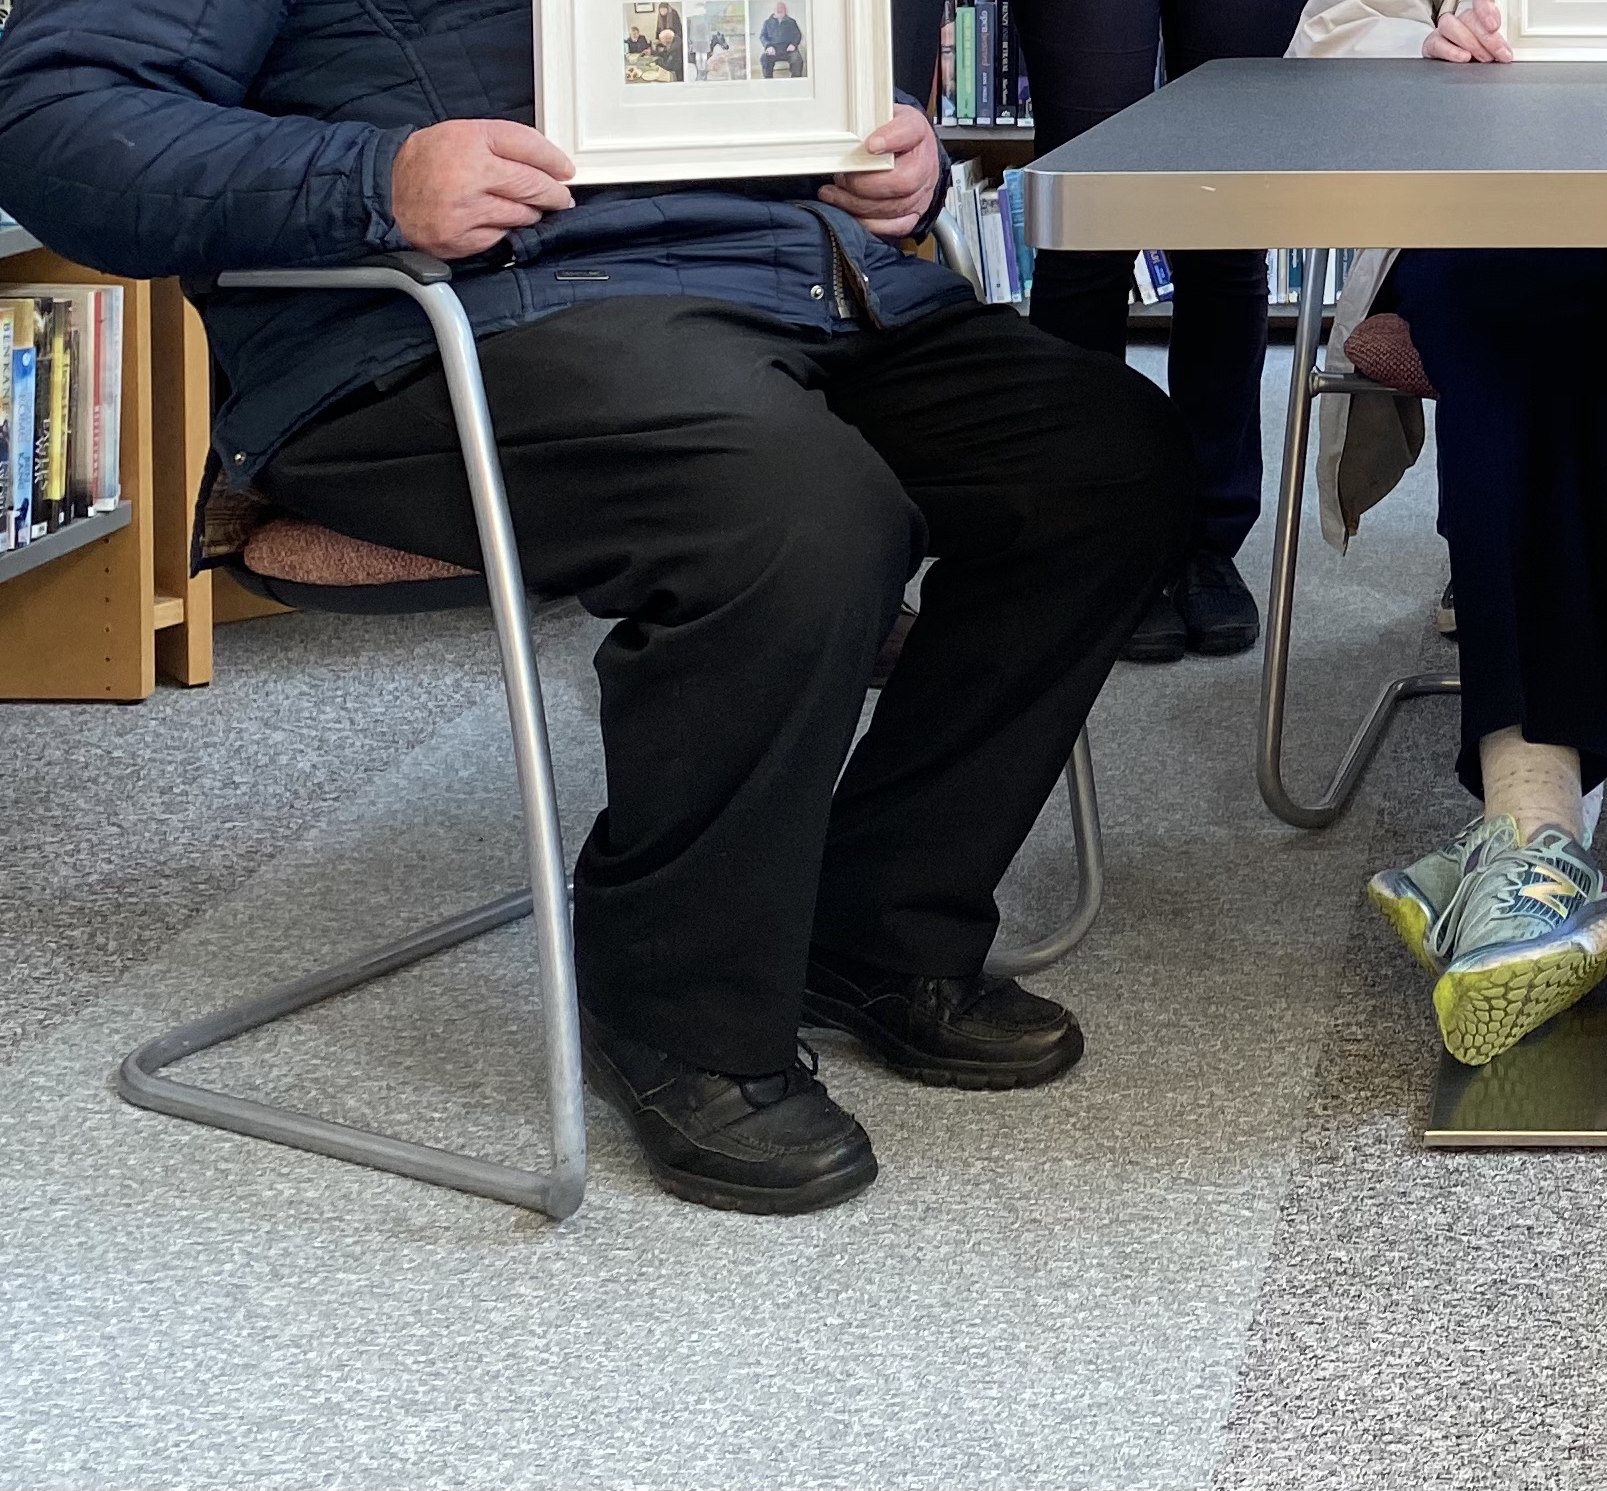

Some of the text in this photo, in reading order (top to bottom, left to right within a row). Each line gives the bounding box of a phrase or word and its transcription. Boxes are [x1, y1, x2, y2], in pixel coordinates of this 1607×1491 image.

[2, 322, 11, 412] BEN KANE
[34, 437, 43, 484] WAR
